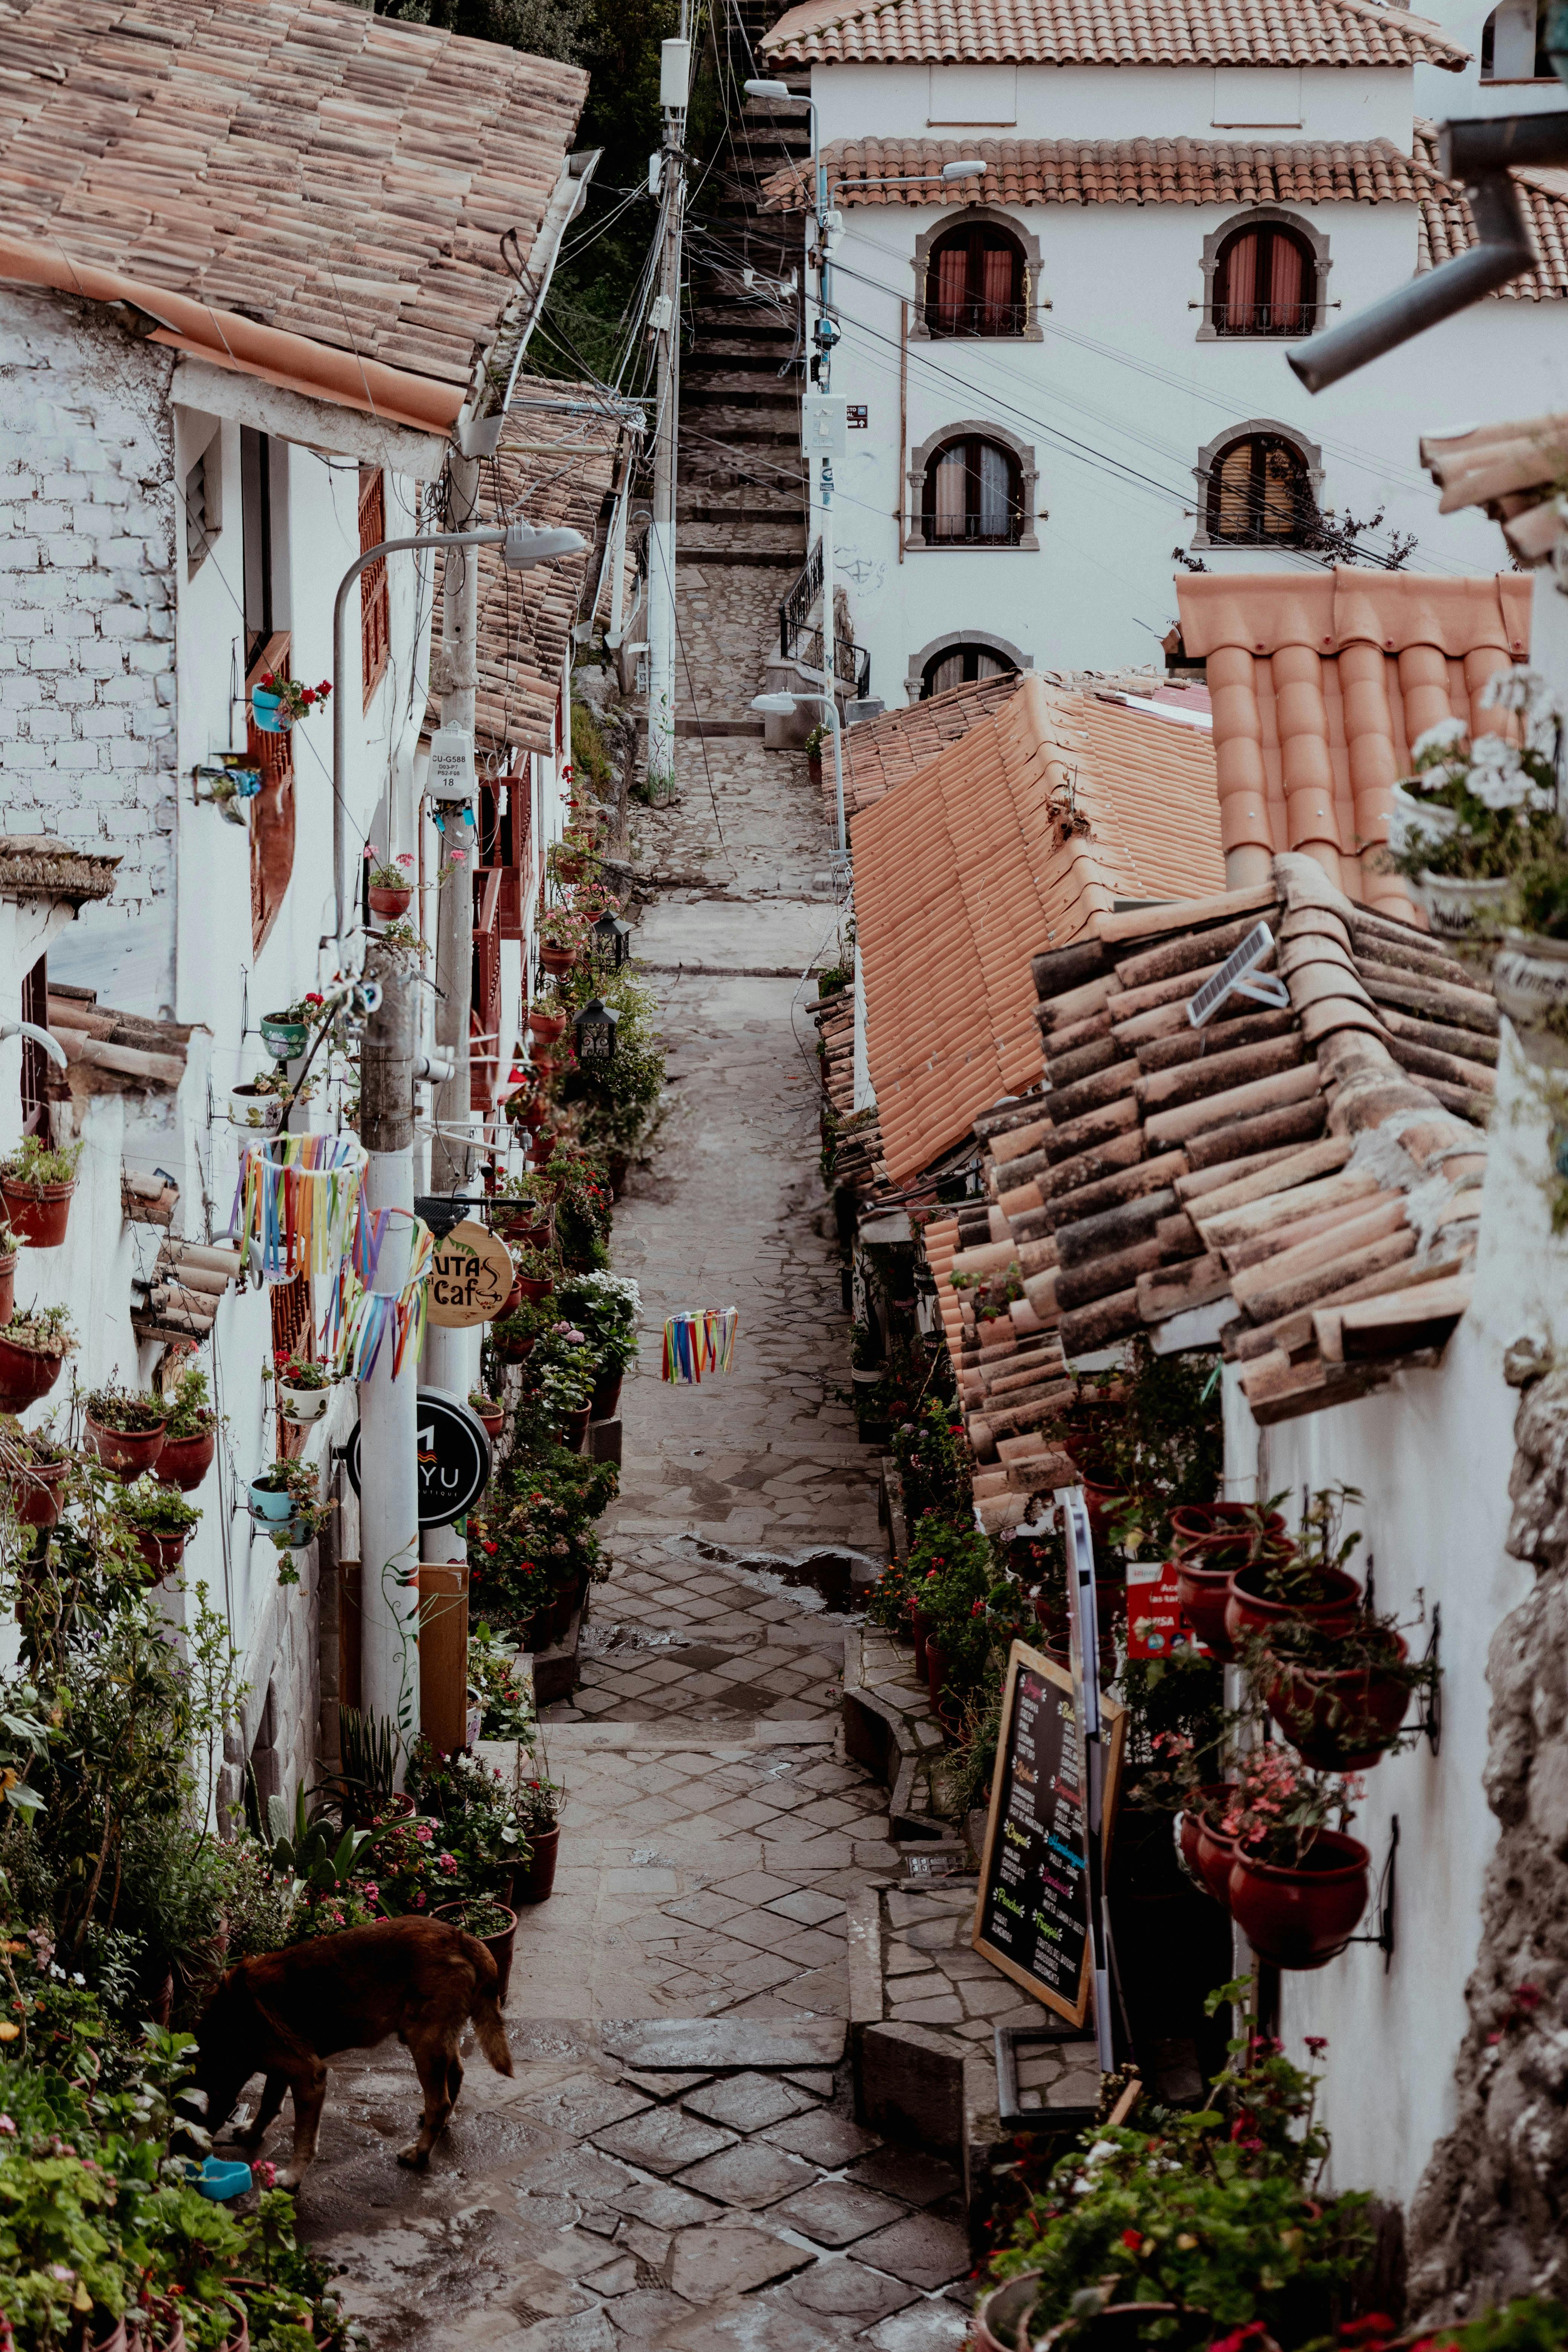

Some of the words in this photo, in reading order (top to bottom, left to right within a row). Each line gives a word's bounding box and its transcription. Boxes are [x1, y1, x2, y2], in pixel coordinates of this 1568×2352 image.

[443, 778, 454, 786] 18
[430, 1256, 479, 1277] UTA
[420, 1465, 459, 1488] YU
[1011, 1793, 1035, 1817] CHOCOLATE
[1018, 1810, 1025, 1822] DE
[1024, 1815, 1044, 1835] MANZANA
[1001, 1856, 1026, 1880] CHOCOLATE
[1049, 1852, 1062, 1868] POLLO
[1000, 1867, 1017, 1886] FRUTAS
[1044, 1886, 1057, 1902] POLLO
[1037, 1936, 1053, 1955] FRUTOS
[1060, 1954, 1076, 1973] BOSQUE
